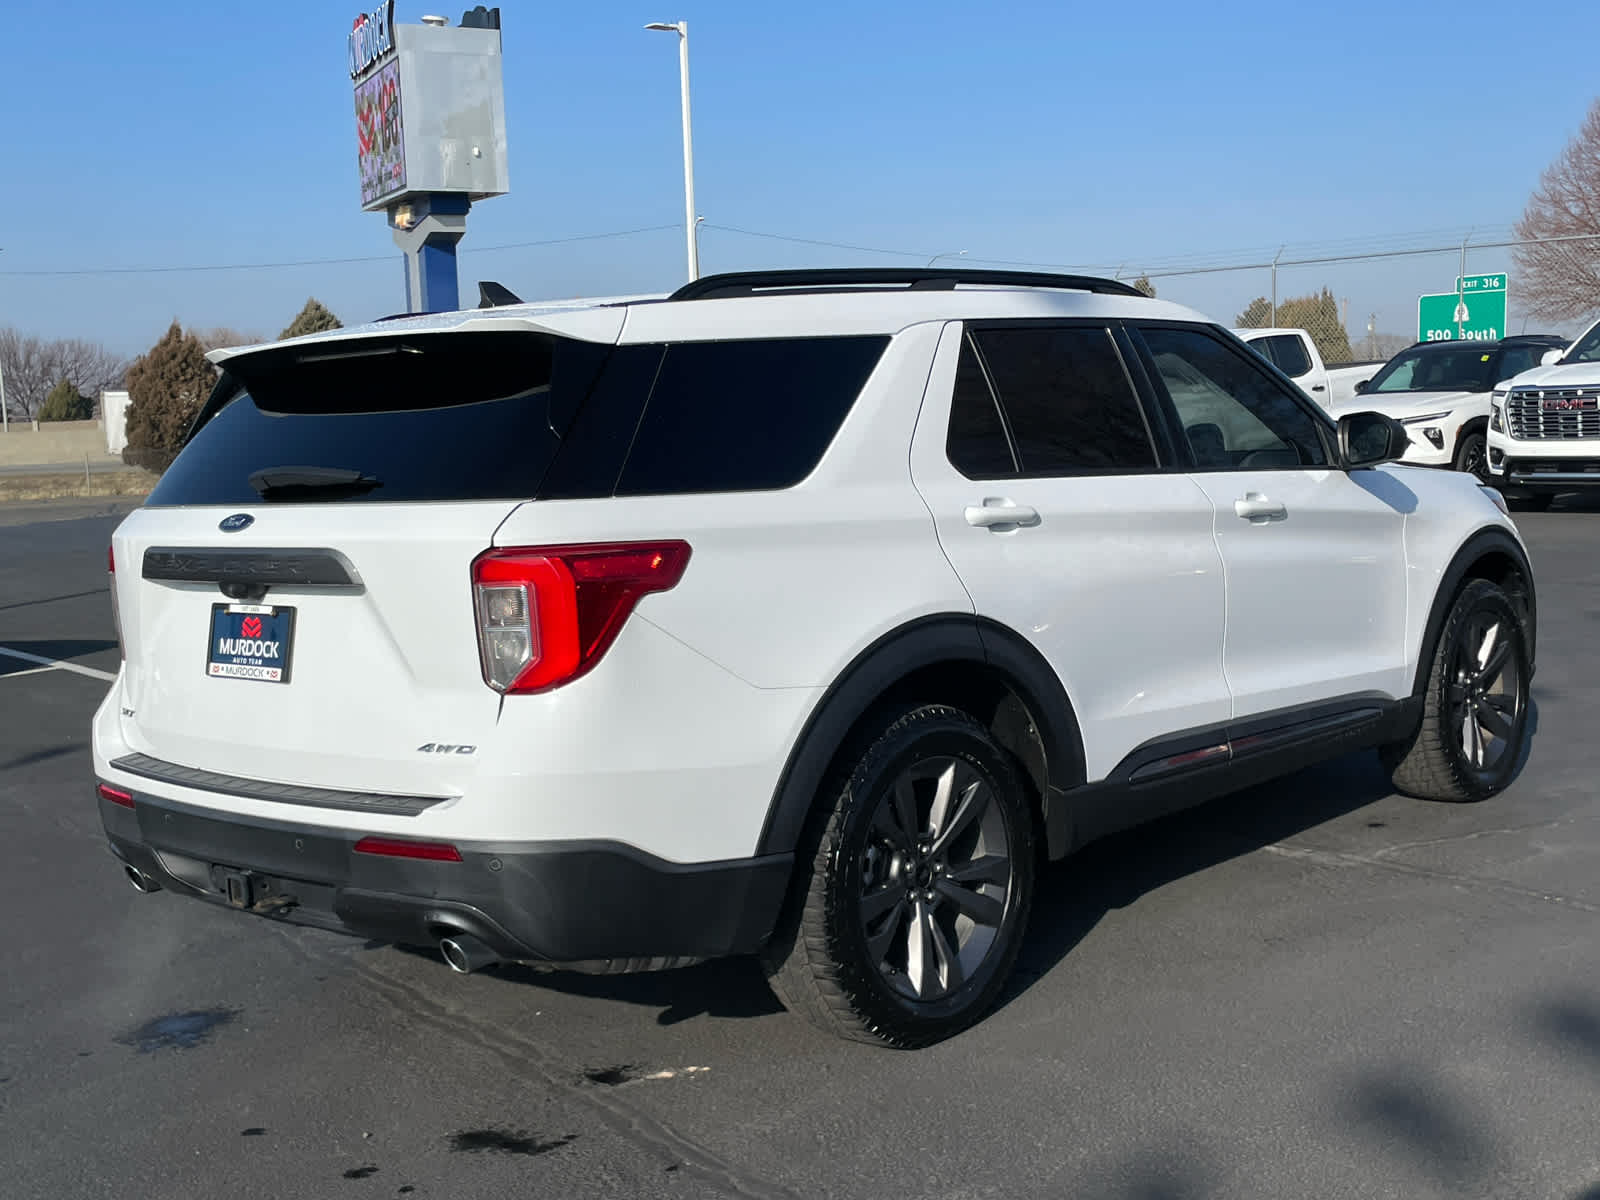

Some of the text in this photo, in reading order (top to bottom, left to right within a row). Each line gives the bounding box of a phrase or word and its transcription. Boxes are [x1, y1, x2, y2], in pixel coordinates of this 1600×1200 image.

[1482, 278, 1500, 288] 316
[1427, 328, 1497, 341] 500 South
[219, 637, 280, 658] MURDOCK
[225, 666, 264, 677] MURDOCK
[417, 743, 477, 754] 4WD
